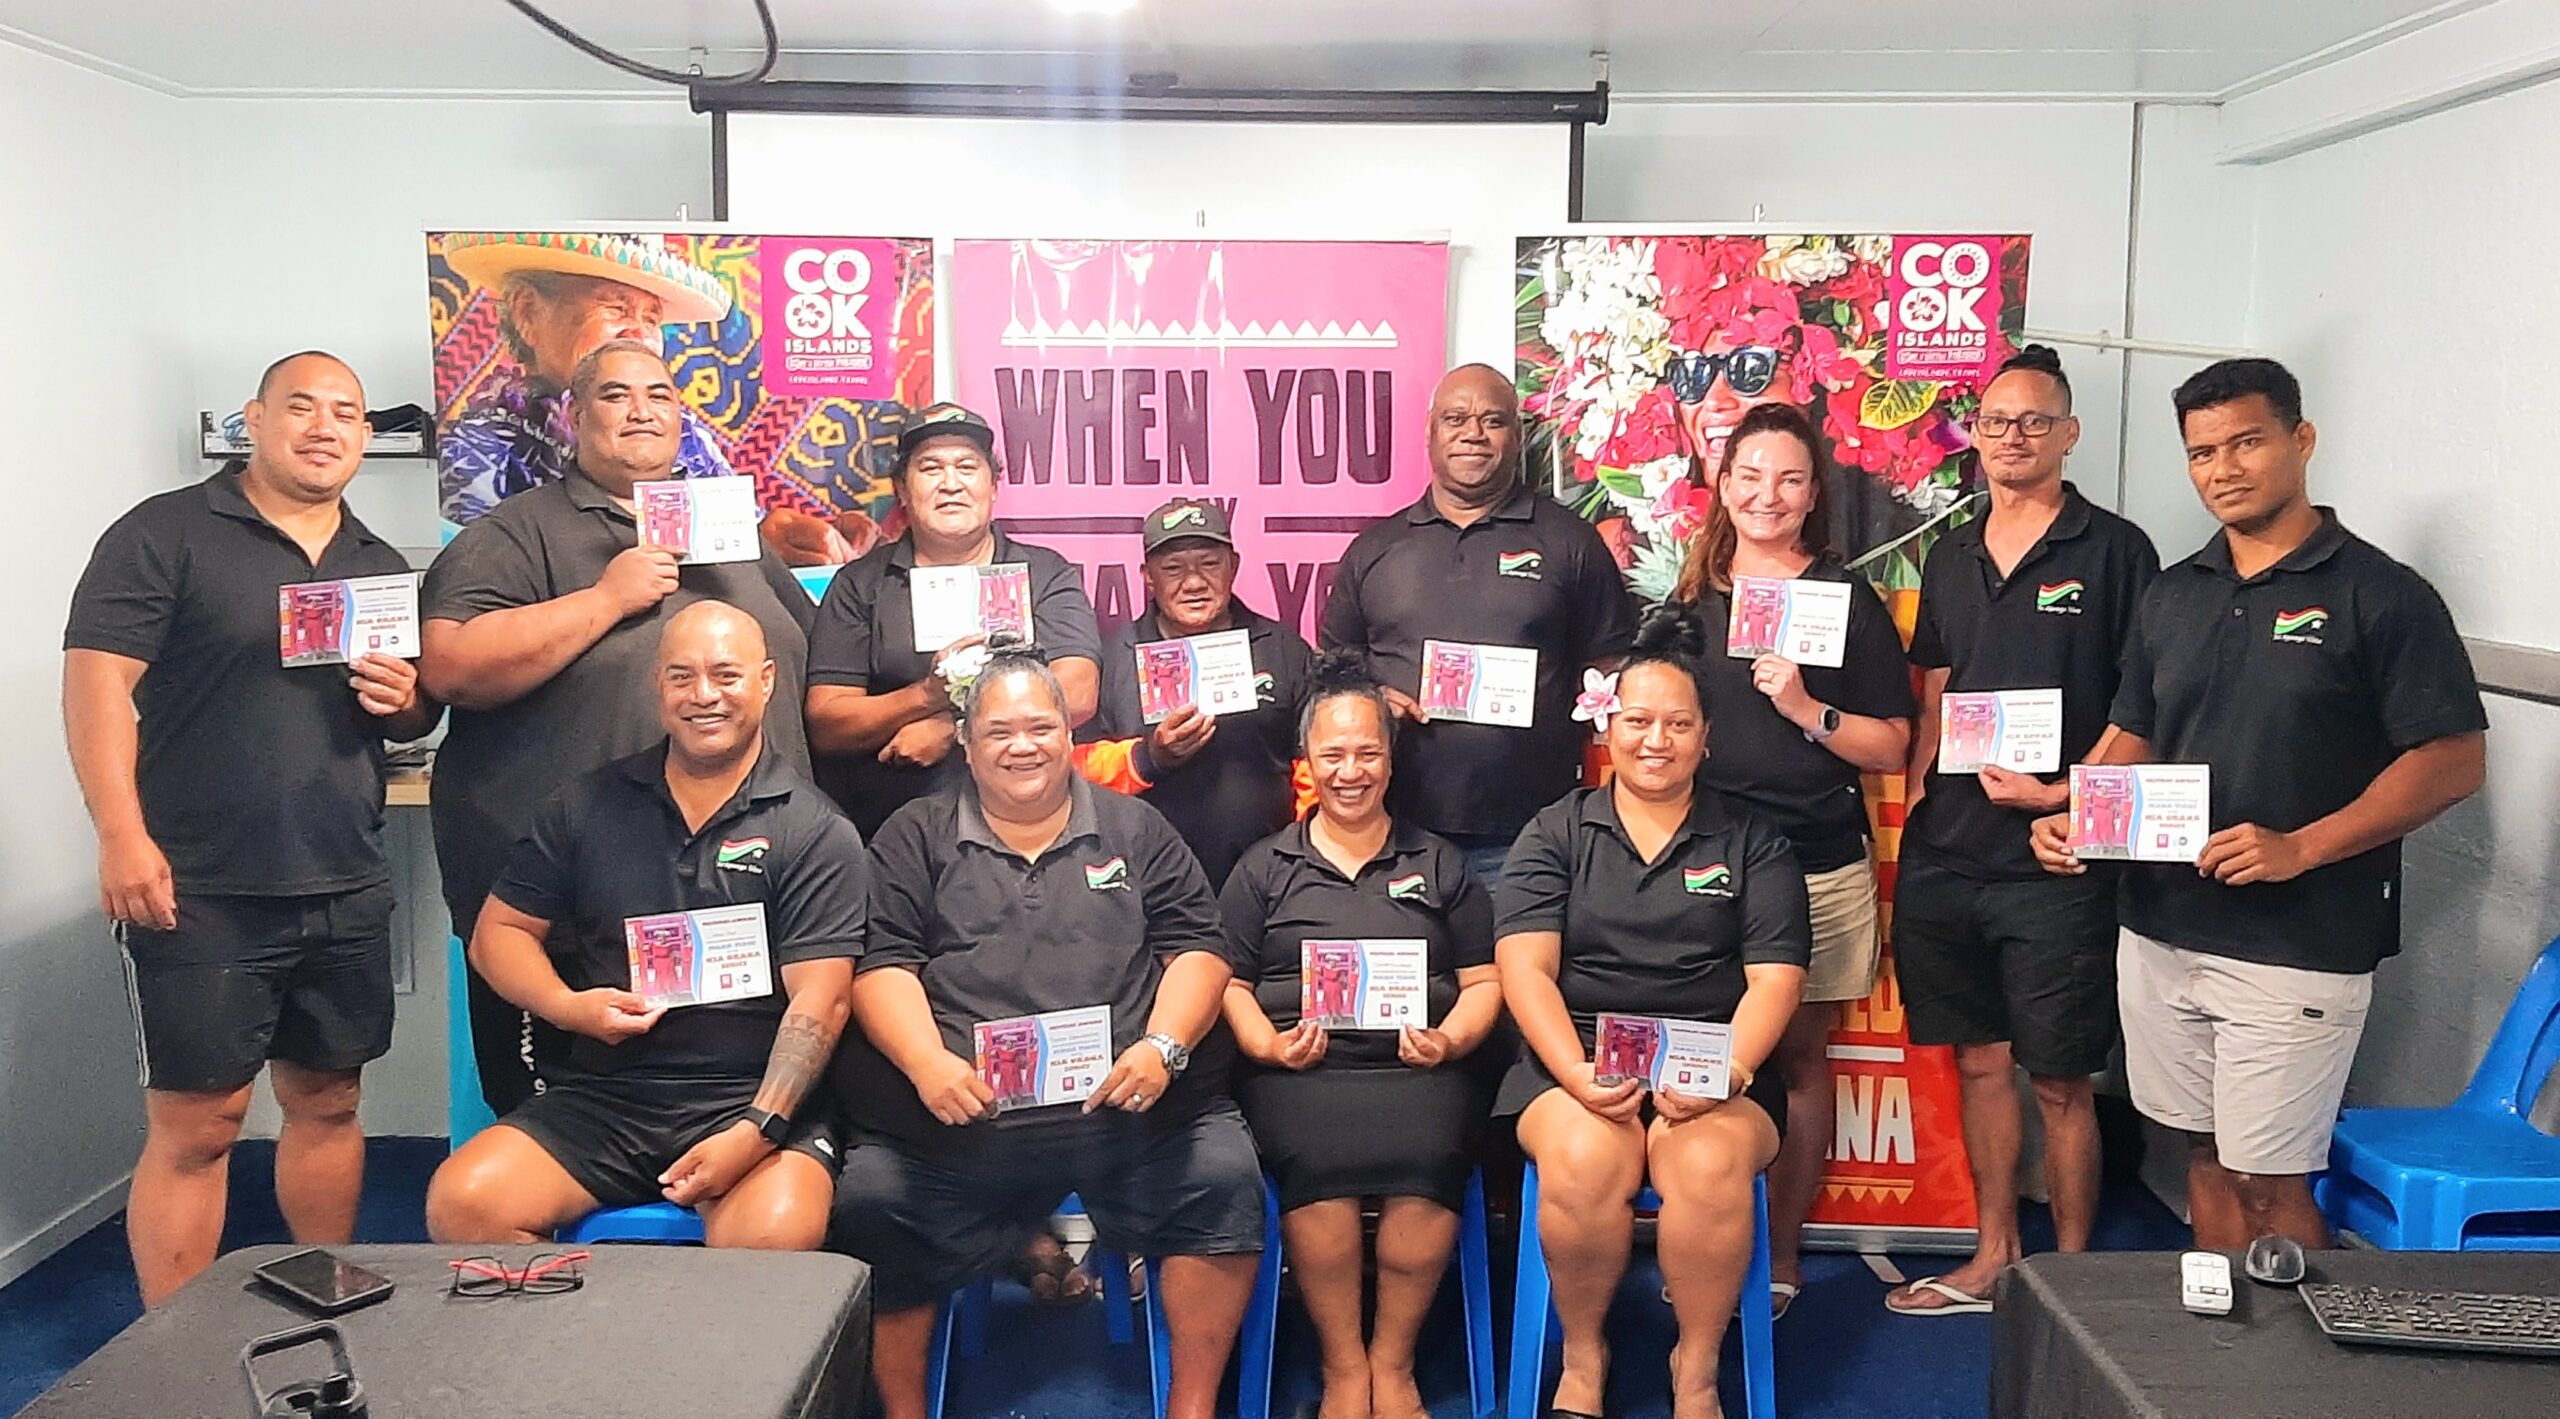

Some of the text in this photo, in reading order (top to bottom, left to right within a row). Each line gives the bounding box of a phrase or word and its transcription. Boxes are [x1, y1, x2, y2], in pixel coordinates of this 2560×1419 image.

[785, 339, 873, 354] ISLANDS
[1896, 331, 1987, 347] ISLANDS
[994, 368, 1393, 486] WHEN YOU
[1824, 1074, 1917, 1165] NA
